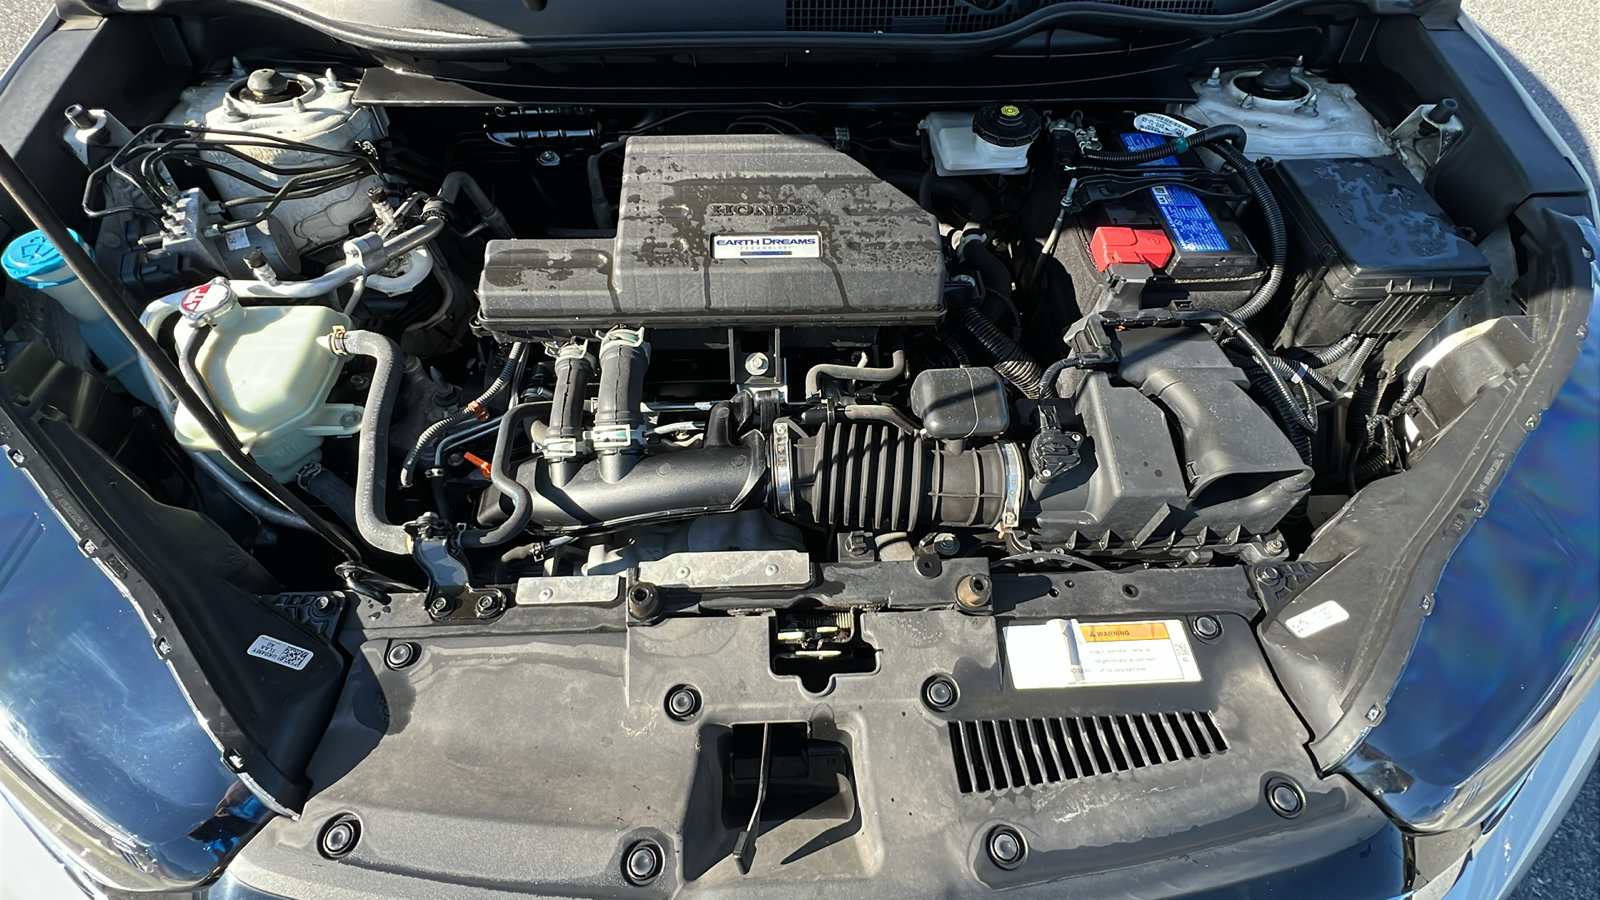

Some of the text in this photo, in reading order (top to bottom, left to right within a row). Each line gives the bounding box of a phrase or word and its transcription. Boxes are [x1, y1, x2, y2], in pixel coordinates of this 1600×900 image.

[710, 203, 819, 217] HONDA
[762, 238, 816, 246] DREAMS
[1096, 629, 1131, 638] WARNING
